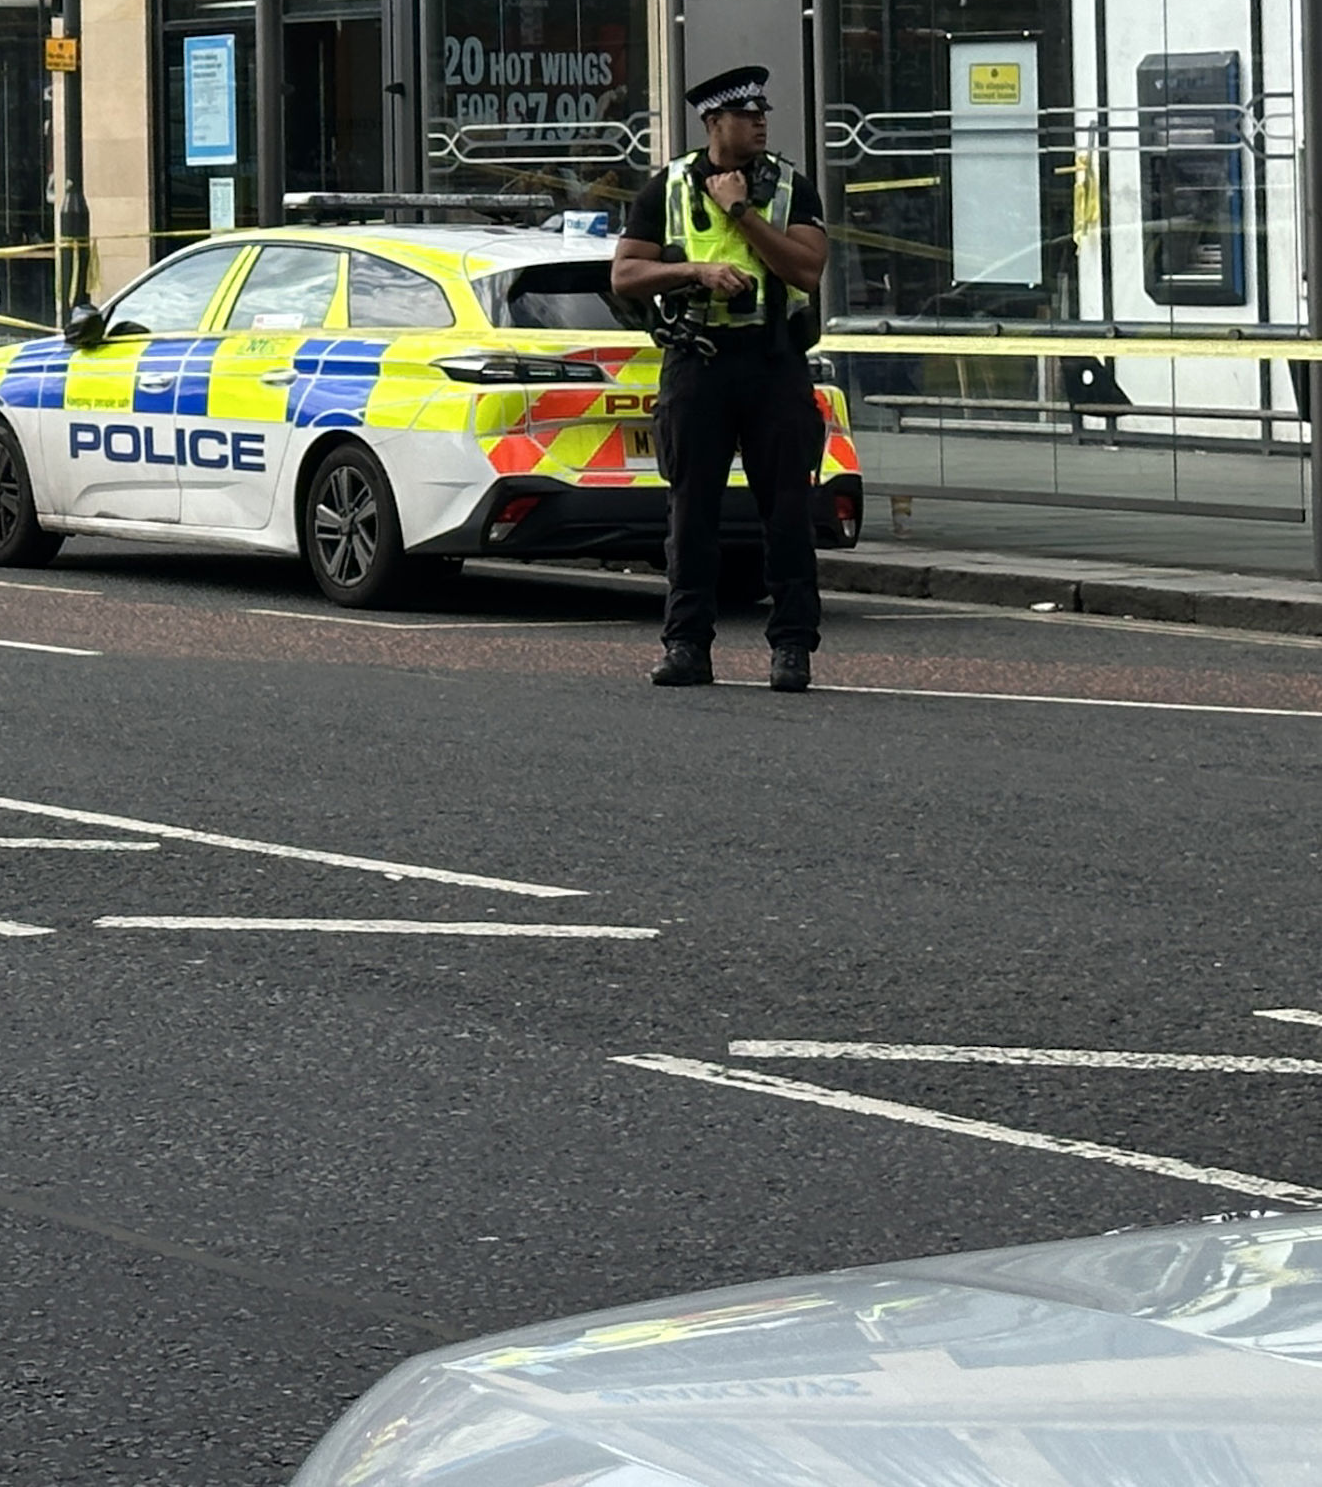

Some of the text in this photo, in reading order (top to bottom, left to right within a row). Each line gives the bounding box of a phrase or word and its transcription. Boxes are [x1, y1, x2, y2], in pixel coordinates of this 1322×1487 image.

[445, 35, 613, 86] 20 HOT WINGS
[69, 421, 267, 472] POLICE
